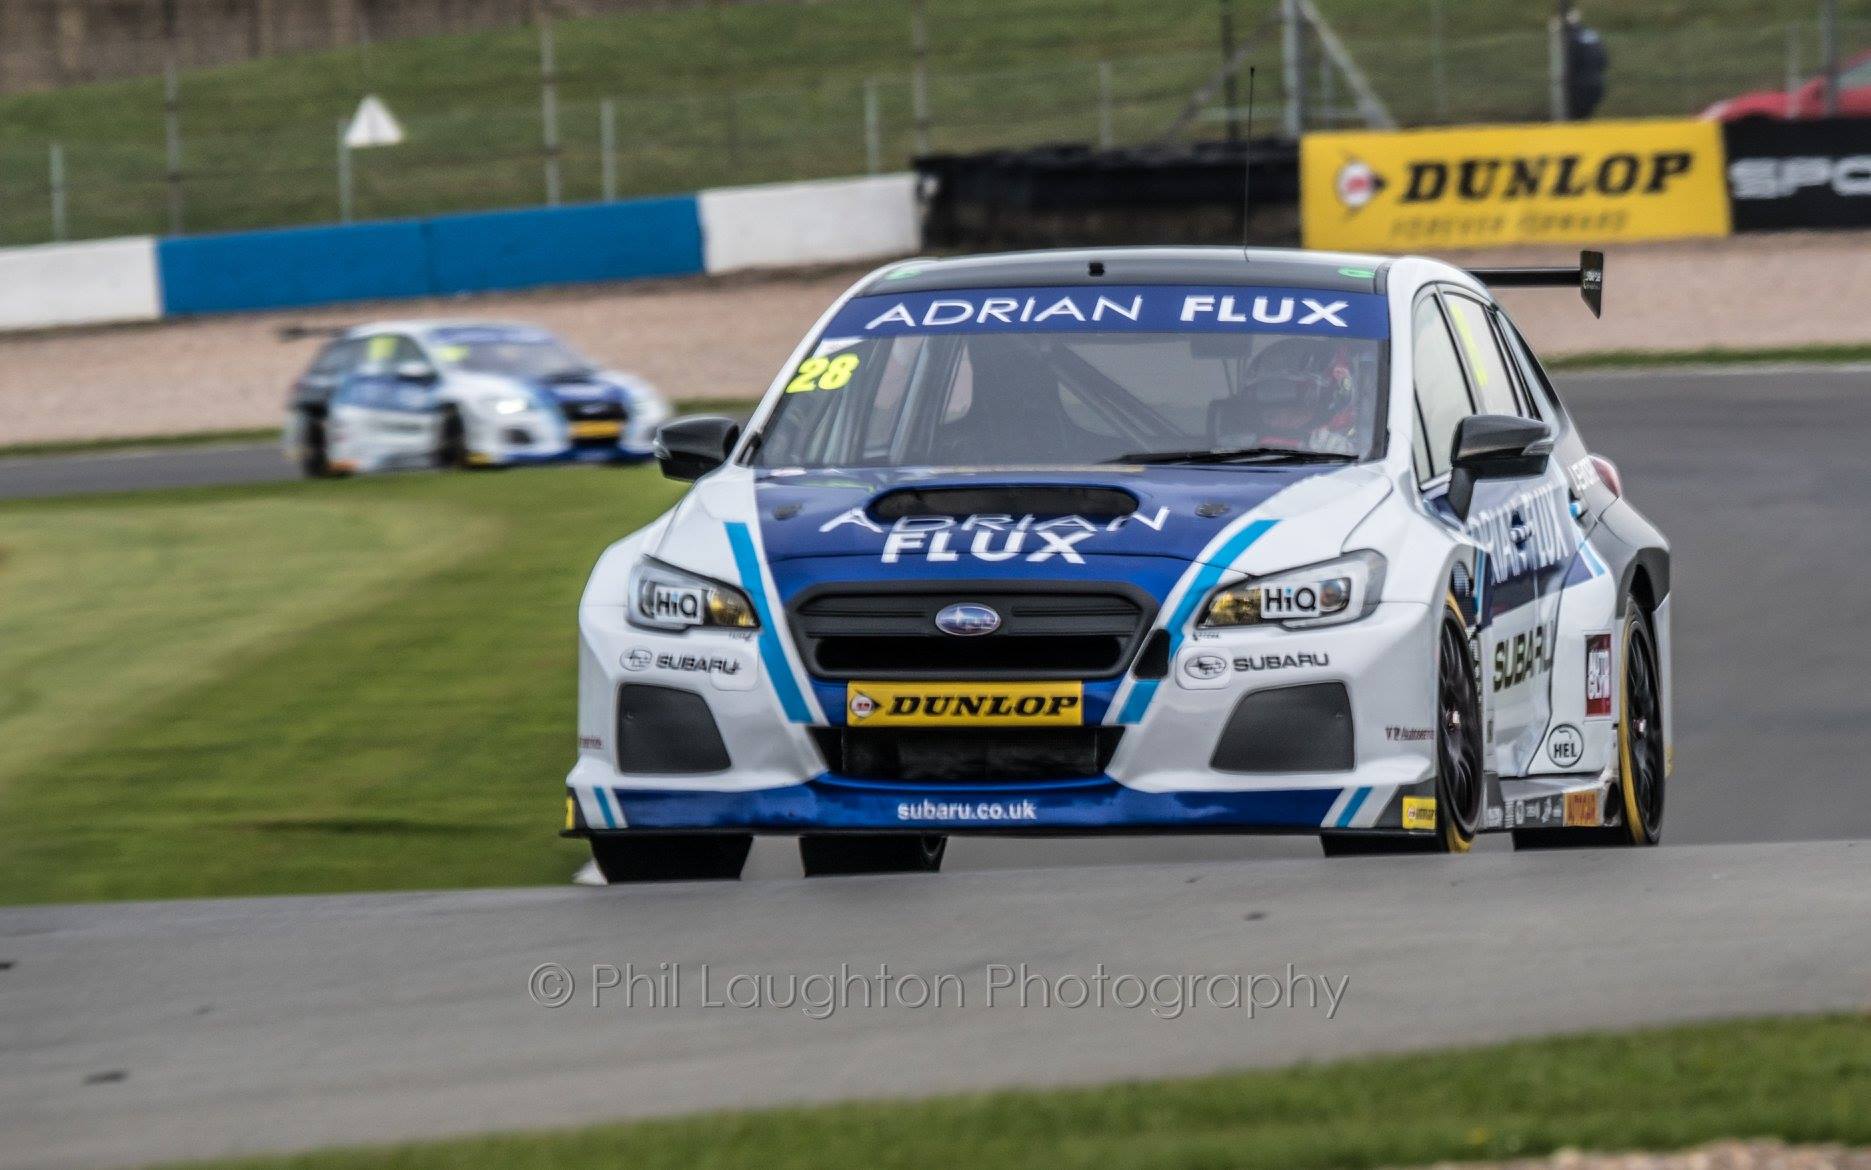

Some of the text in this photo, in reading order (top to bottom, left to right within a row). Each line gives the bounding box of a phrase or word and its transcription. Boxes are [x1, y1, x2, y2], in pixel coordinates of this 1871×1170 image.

[1397, 150, 1693, 205] DUNLOP
[865, 295, 1348, 330] ADRIAN FLUX
[786, 353, 859, 394] 28
[819, 506, 1170, 534] ADRIAN
[880, 529, 1095, 565] FLUX
[656, 591, 698, 619] HiQ
[1264, 586, 1316, 612] HiQ
[656, 655, 738, 675] SUBARU
[1233, 653, 1329, 672] SUBARU
[1494, 622, 1554, 692] SUBARU
[887, 696, 1078, 716] DUNLOP
[1553, 742, 1578, 759] HEL
[897, 799, 1036, 820] subaru.co.uk
